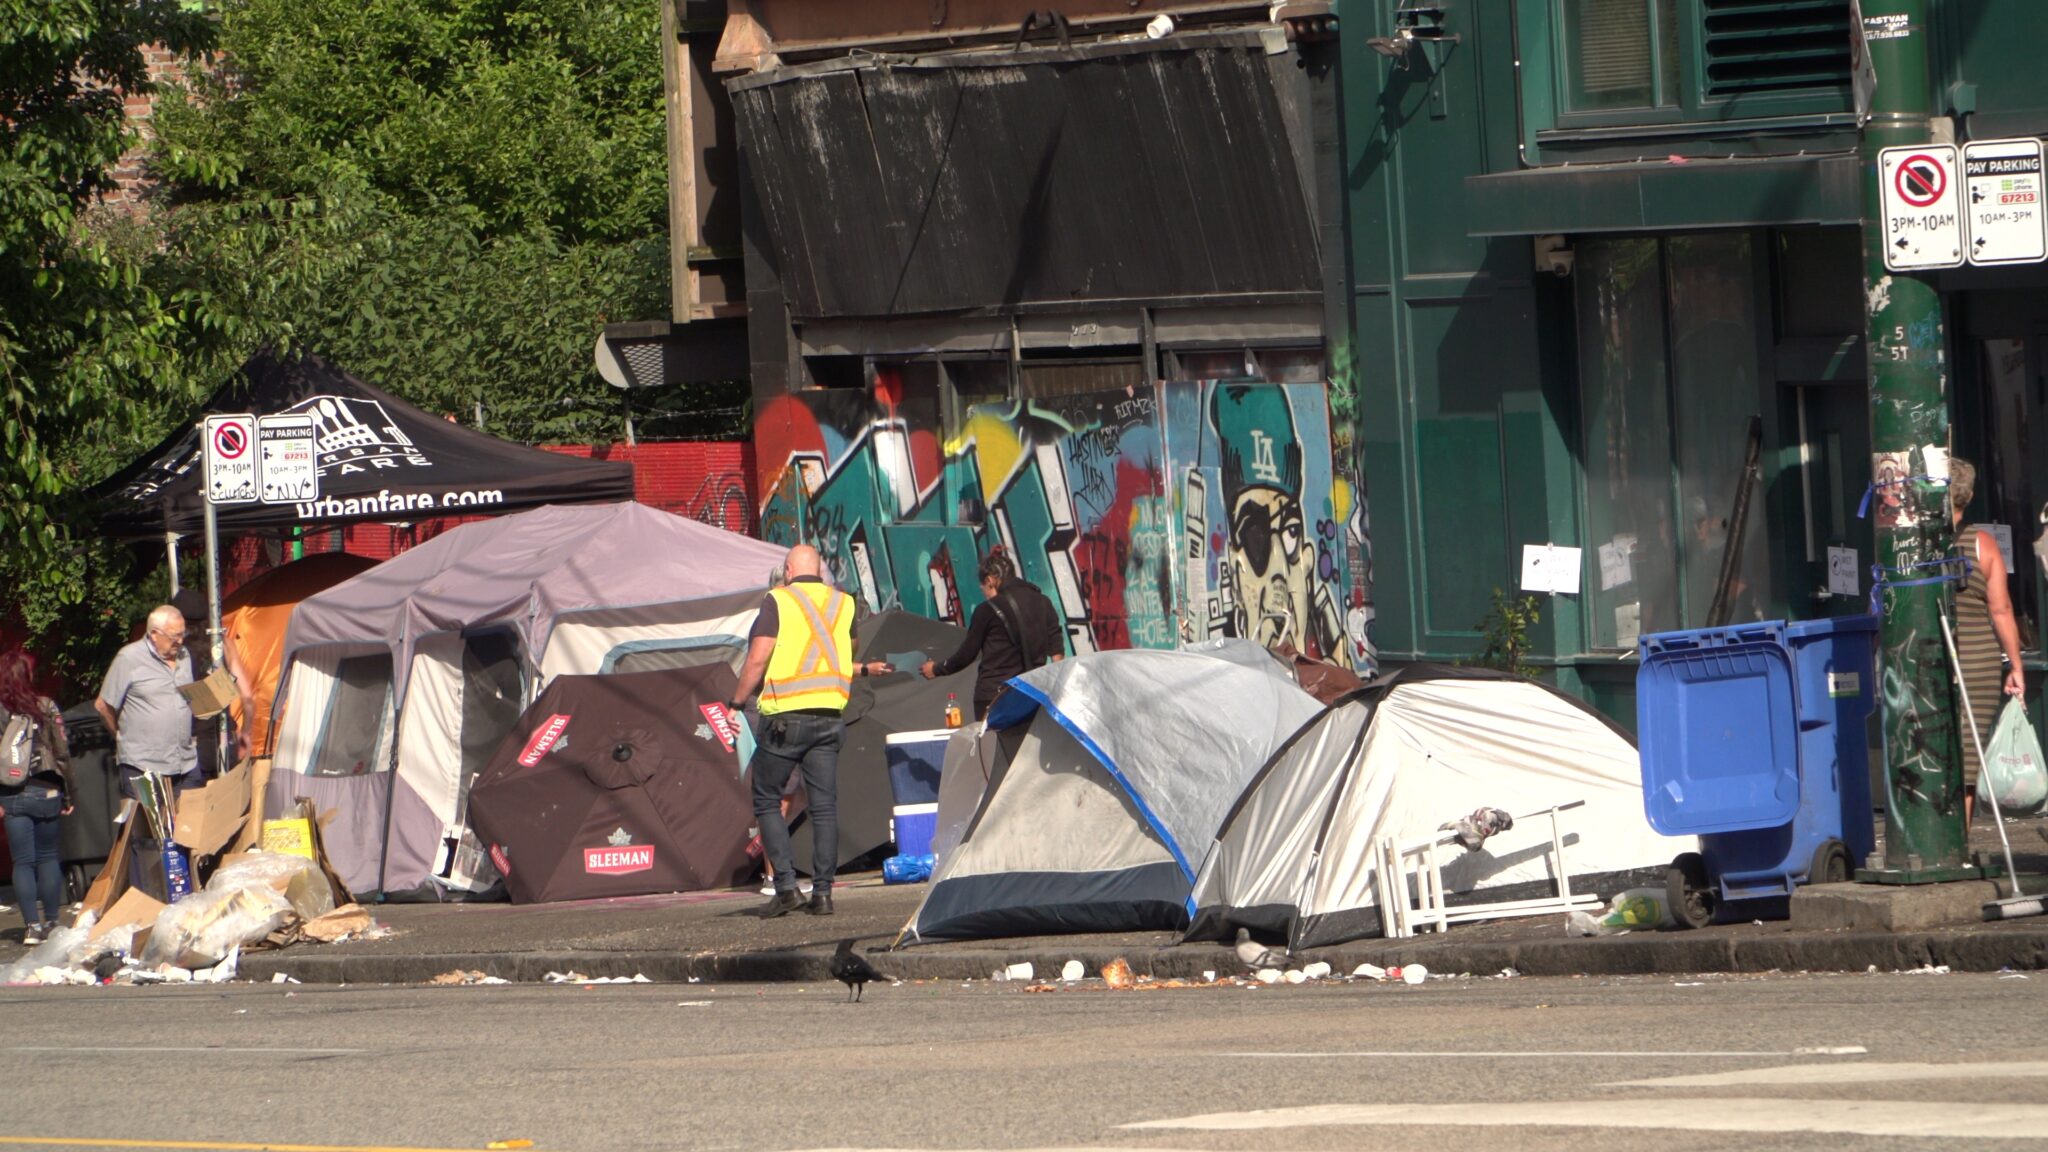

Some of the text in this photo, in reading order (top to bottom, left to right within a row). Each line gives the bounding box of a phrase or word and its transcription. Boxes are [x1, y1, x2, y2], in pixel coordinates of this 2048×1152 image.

[1966, 158, 2040, 174] PAY PARKING
[2000, 193, 2035, 204] 67213
[1895, 326, 1904, 341] 5
[260, 428, 312, 439] PAY PARKING
[284, 452, 309, 461] 67213
[323, 446, 419, 463] RBAN
[1251, 430, 1280, 484] LA
[523, 718, 567, 765] SLEEMAN
[589, 851, 649, 868] SLEEMAN
